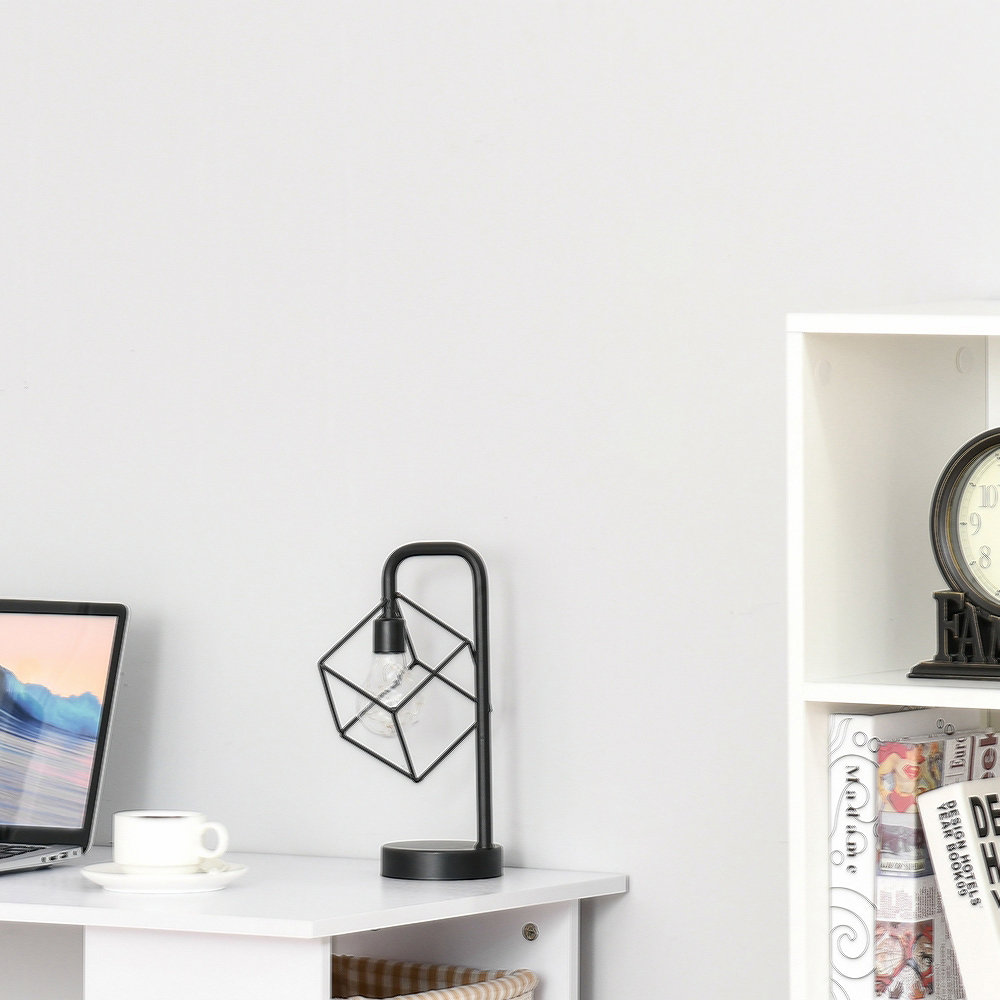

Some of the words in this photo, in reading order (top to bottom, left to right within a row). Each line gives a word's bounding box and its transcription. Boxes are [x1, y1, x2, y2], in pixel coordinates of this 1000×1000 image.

[978, 484, 999, 509] 10
[970, 512, 982, 536] 9
[979, 545, 992, 569] 8
[845, 765, 860, 874] Madame
[937, 802, 954, 839] YEAR
[947, 800, 967, 850] DESIGN
[961, 854, 982, 906] HOTELS
